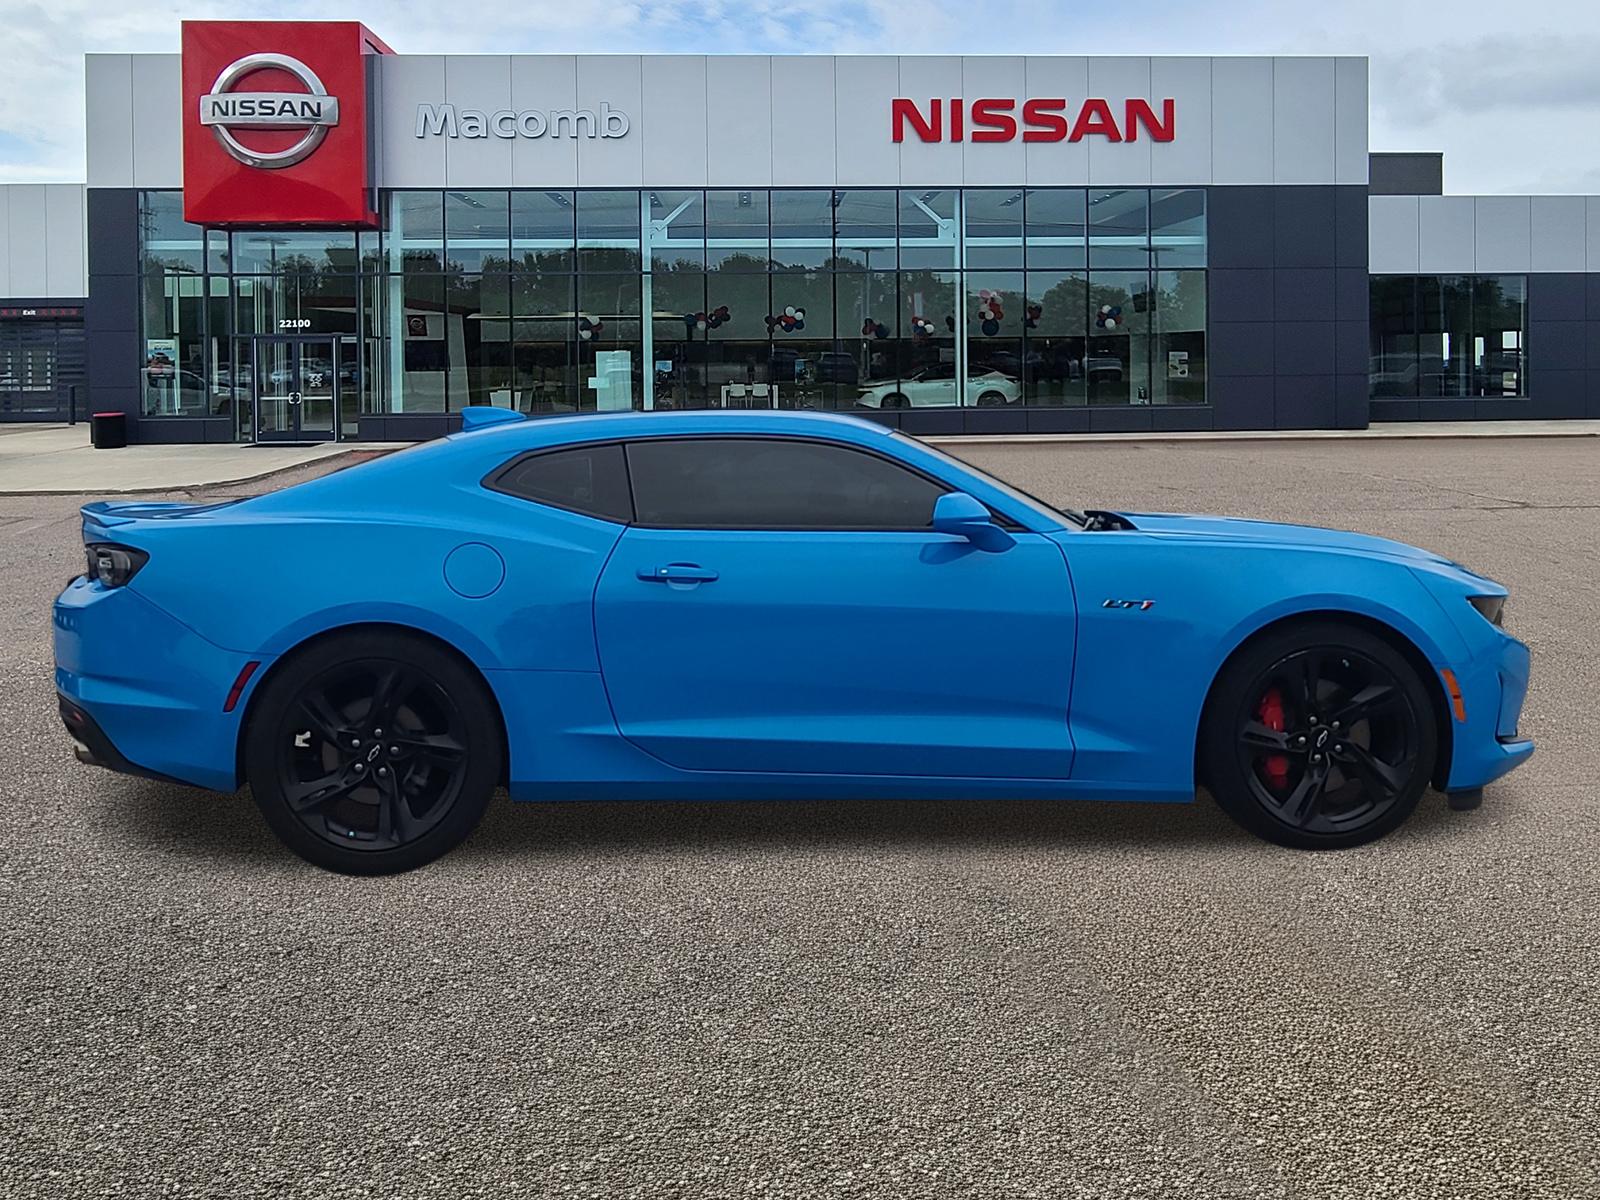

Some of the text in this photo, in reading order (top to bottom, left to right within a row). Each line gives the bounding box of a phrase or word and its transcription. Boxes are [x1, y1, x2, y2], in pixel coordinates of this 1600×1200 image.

[212, 100, 322, 117] NISSAN
[415, 102, 630, 139] Macomb
[891, 98, 1175, 142] NISSAN
[279, 319, 311, 328] 22100
